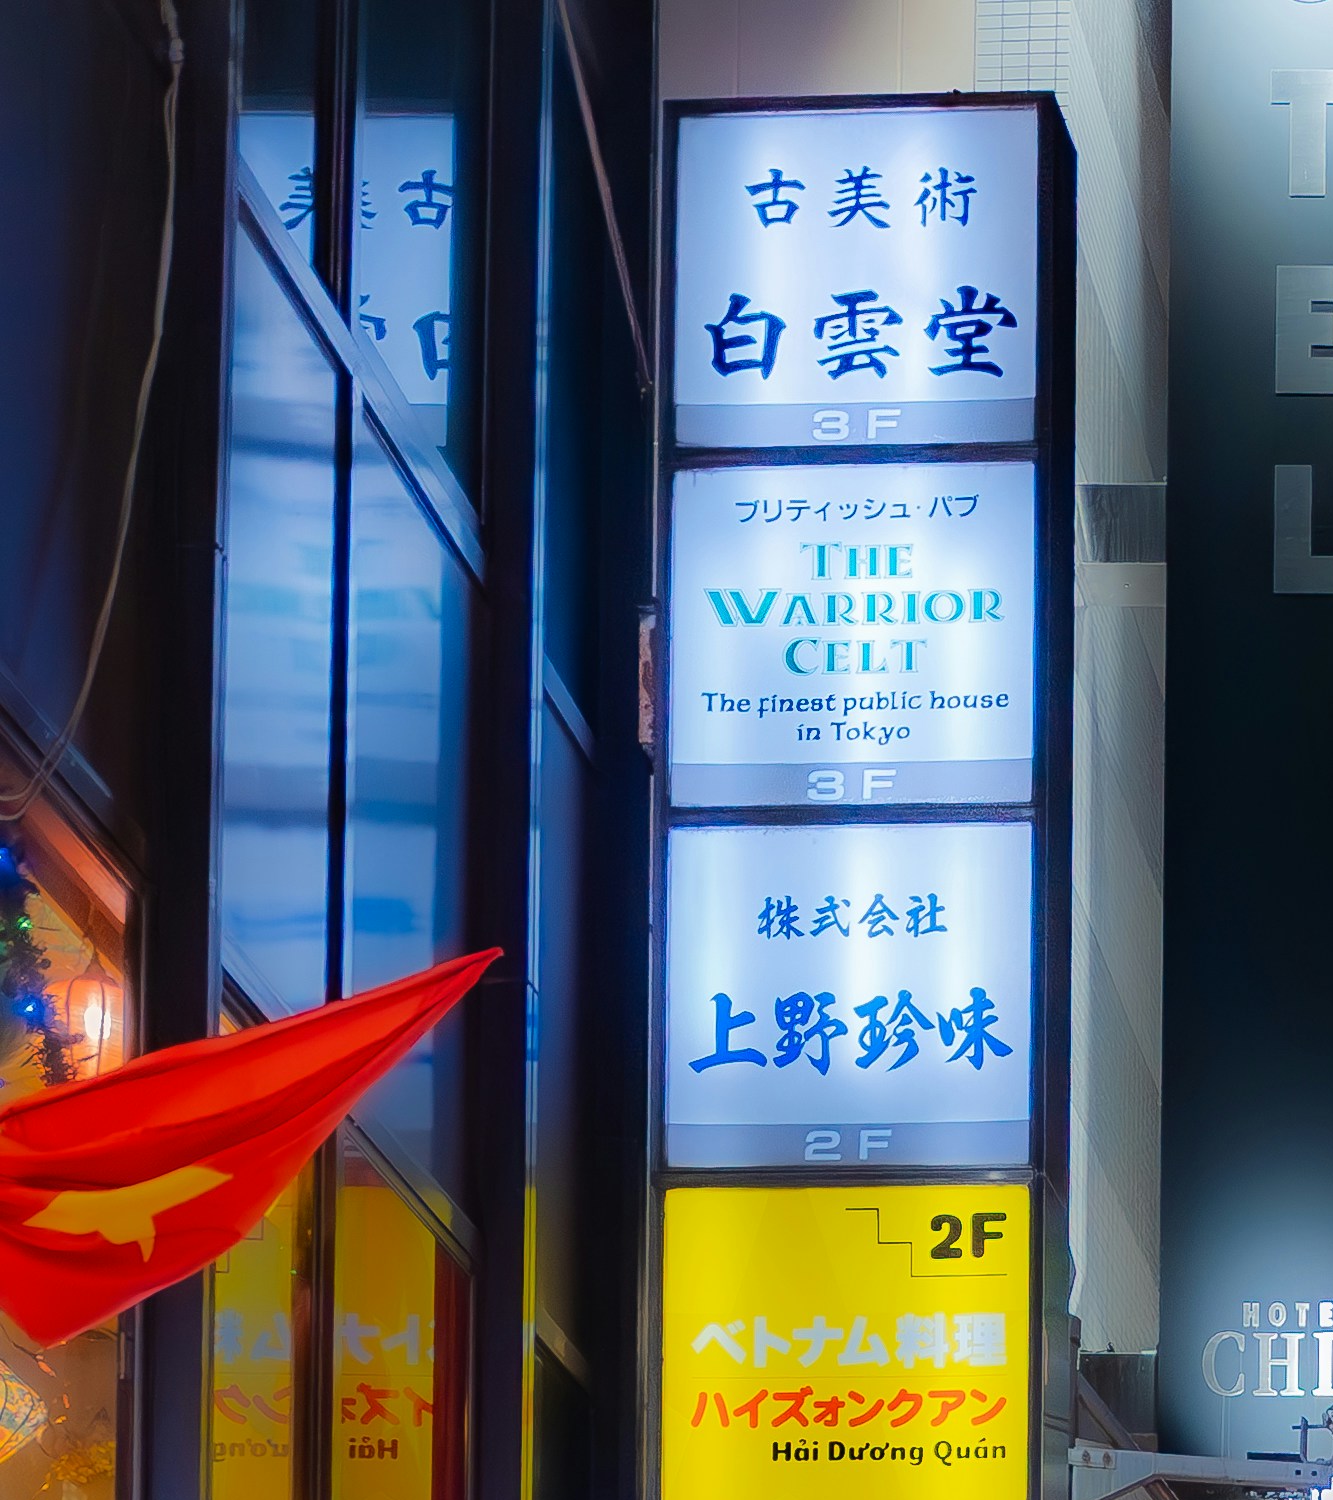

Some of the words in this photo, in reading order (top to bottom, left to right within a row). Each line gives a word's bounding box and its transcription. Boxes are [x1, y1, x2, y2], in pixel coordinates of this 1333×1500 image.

[745, 166, 978, 229] 古美術
[705, 285, 1018, 380] 白雲堂
[812, 409, 902, 441] 3F
[735, 494, 980, 523] ブリティッシュ・パブ
[799, 540, 914, 581] THE
[703, 588, 1005, 624] WARRIOR
[783, 636, 928, 676] CELT
[701, 693, 751, 712] The
[758, 693, 837, 717] finest
[843, 689, 923, 716] public
[930, 689, 1009, 710] house
[797, 723, 821, 742] in
[831, 721, 911, 744] Tokyo
[806, 770, 897, 800] 3F
[758, 894, 948, 939] 株式会社
[689, 988, 1013, 1075] 上野珍味
[804, 1130, 893, 1161] 2F
[929, 1211, 1008, 1258] 2F
[691, 1313, 1008, 1370] ベトナム料理
[773, 1437, 819, 1462] Hải
[828, 1437, 925, 1467] Dương
[933, 1437, 1008, 1464] Quán
